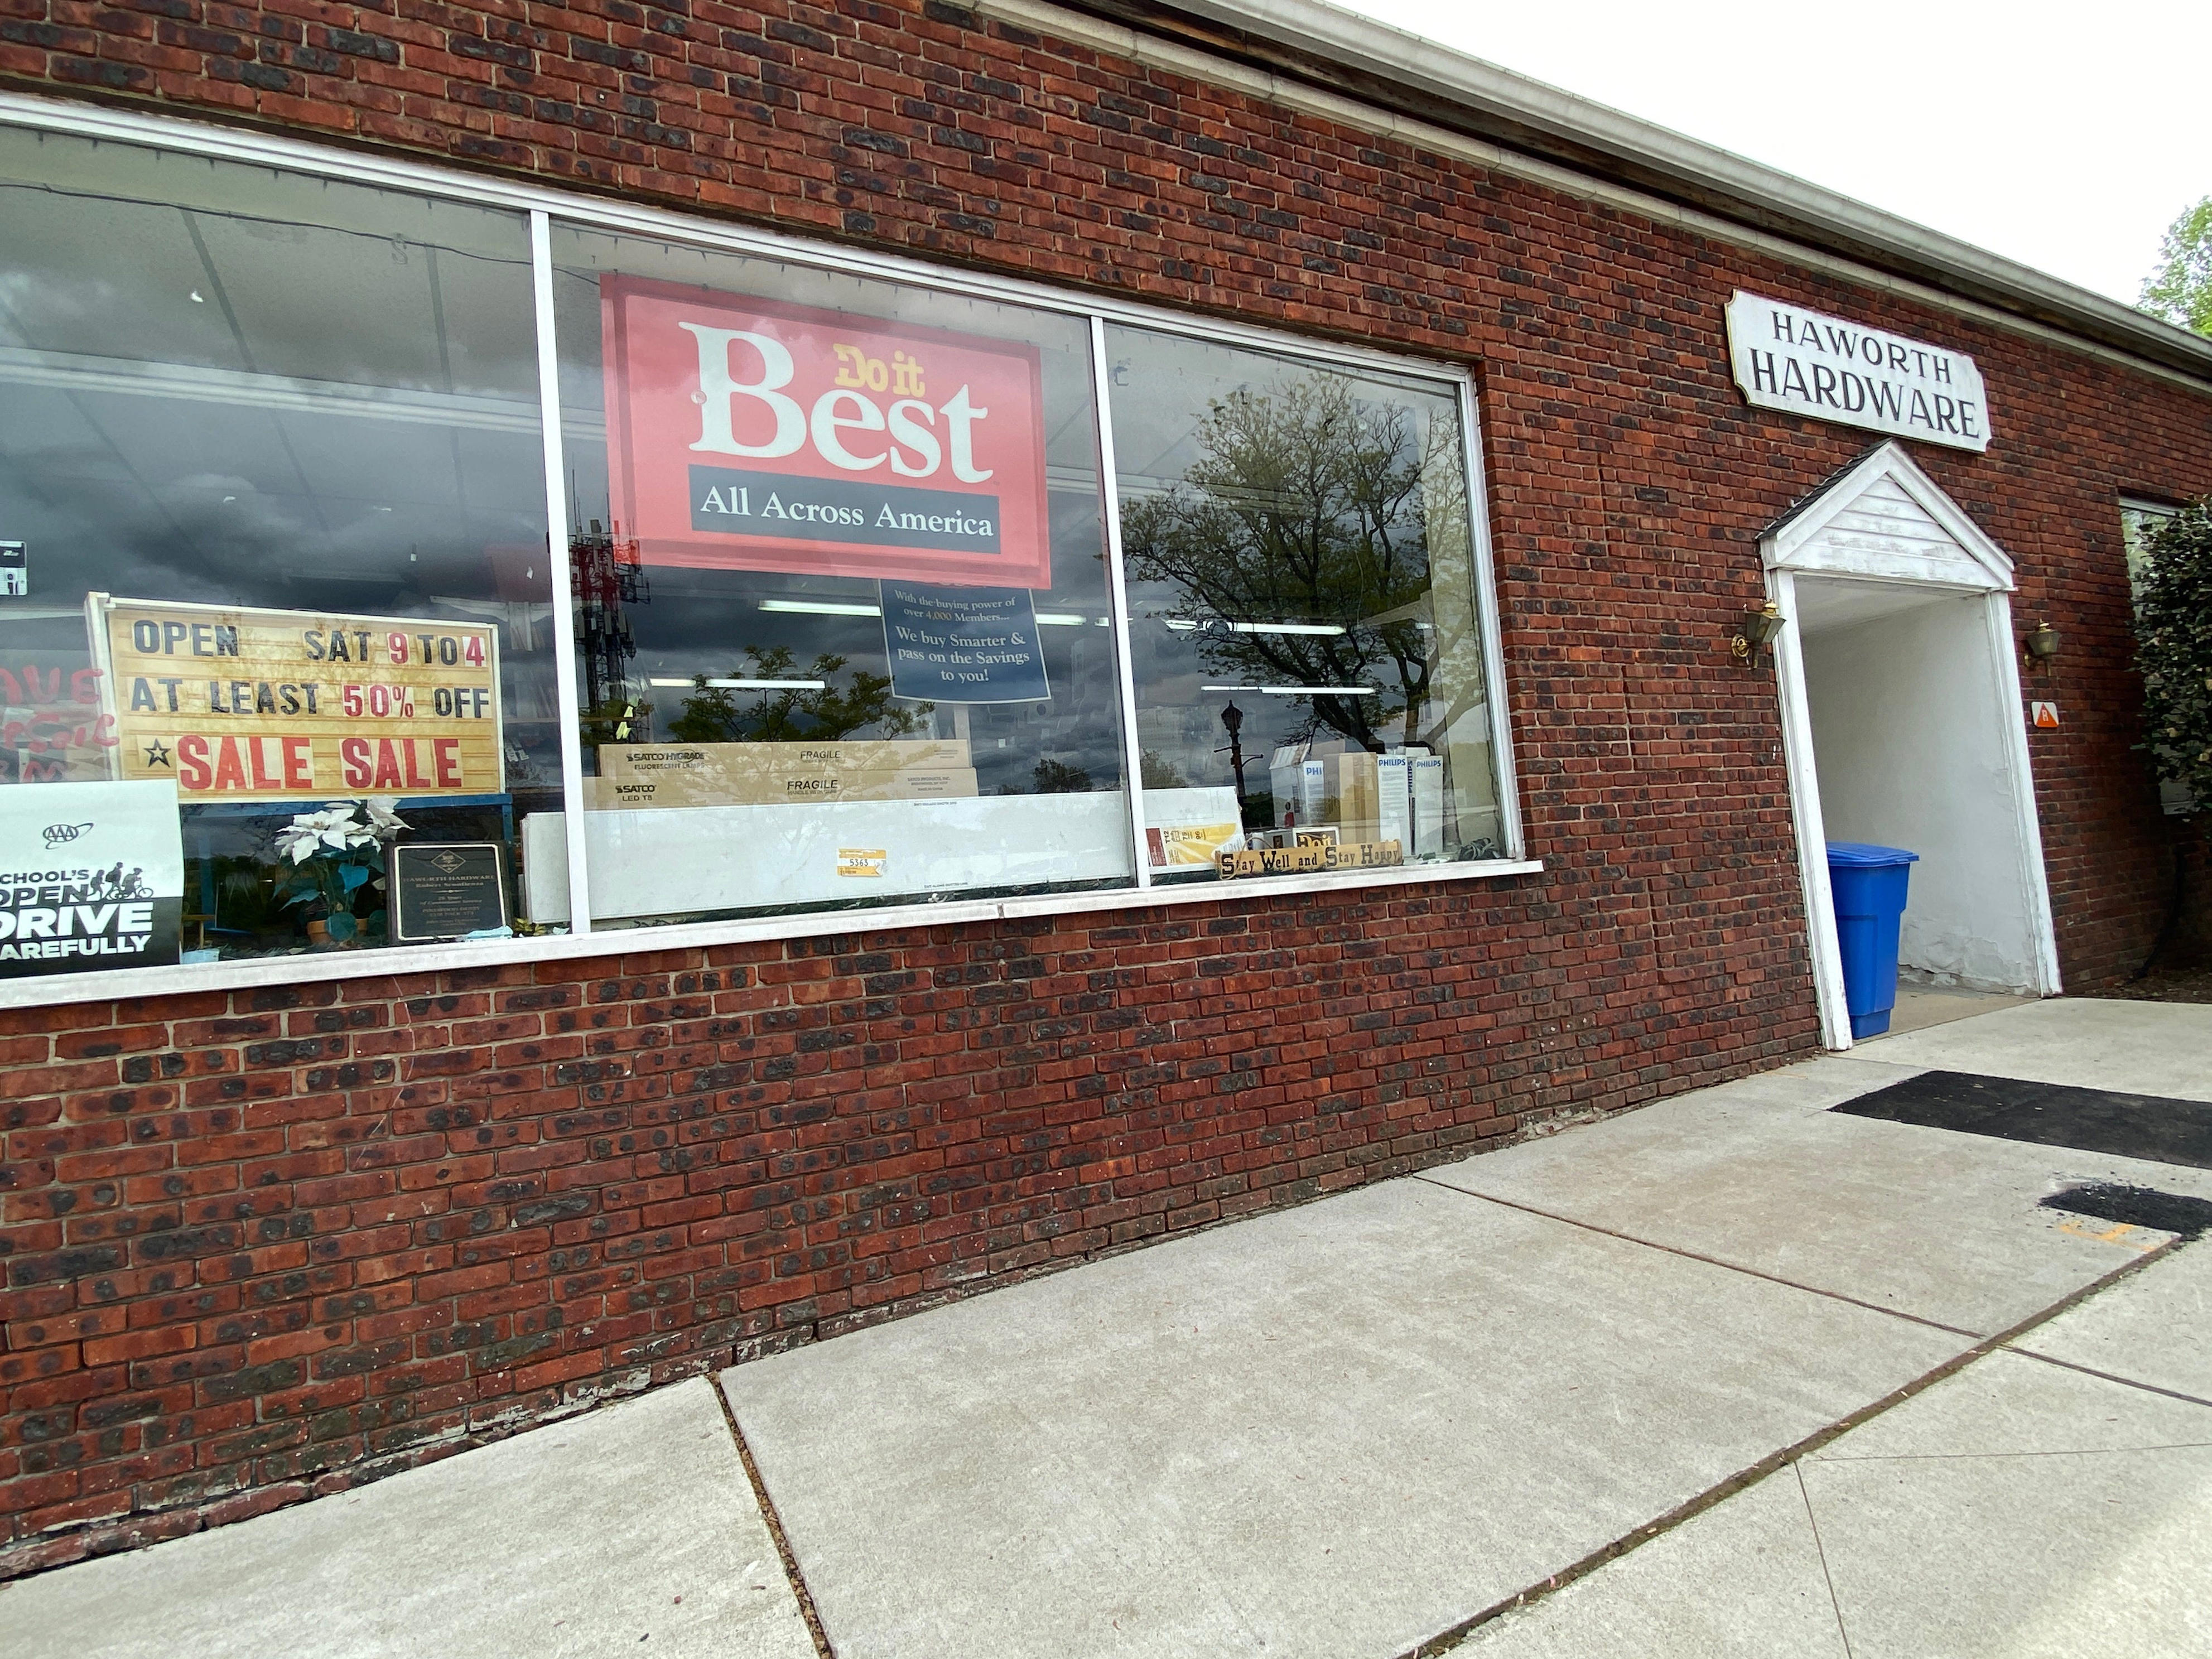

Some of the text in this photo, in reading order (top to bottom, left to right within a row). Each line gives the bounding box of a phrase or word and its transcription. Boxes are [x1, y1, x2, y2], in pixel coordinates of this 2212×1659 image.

[1770, 311, 1952, 384] HAWORTH
[833, 343, 926, 398] Do it
[678, 321, 994, 484] Best
[1748, 347, 1980, 439] HARDWARE
[701, 486, 994, 538] All Across America
[894, 590, 1016, 611] With the buying power of
[904, 608, 923, 618] over
[926, 611, 952, 621] 4,000
[134, 620, 485, 667] OPEN SAT 9 TO 4
[895, 625, 1026, 648] We buy Smarter &
[897, 648, 1030, 664] pass on the Savings
[941, 669, 990, 683] to you!
[131, 677, 489, 718] AT LEAST 50% OFF
[177, 735, 462, 790] SALE SALE
[801, 751, 841, 759] FRAGILE
[787, 780, 838, 790] FRAGILE
[47, 825, 75, 841] AAA
[1221, 853, 1254, 875] Stay
[1260, 851, 1289, 869] Well
[1298, 852, 1317, 866] and
[1325, 847, 1355, 866] Stay
